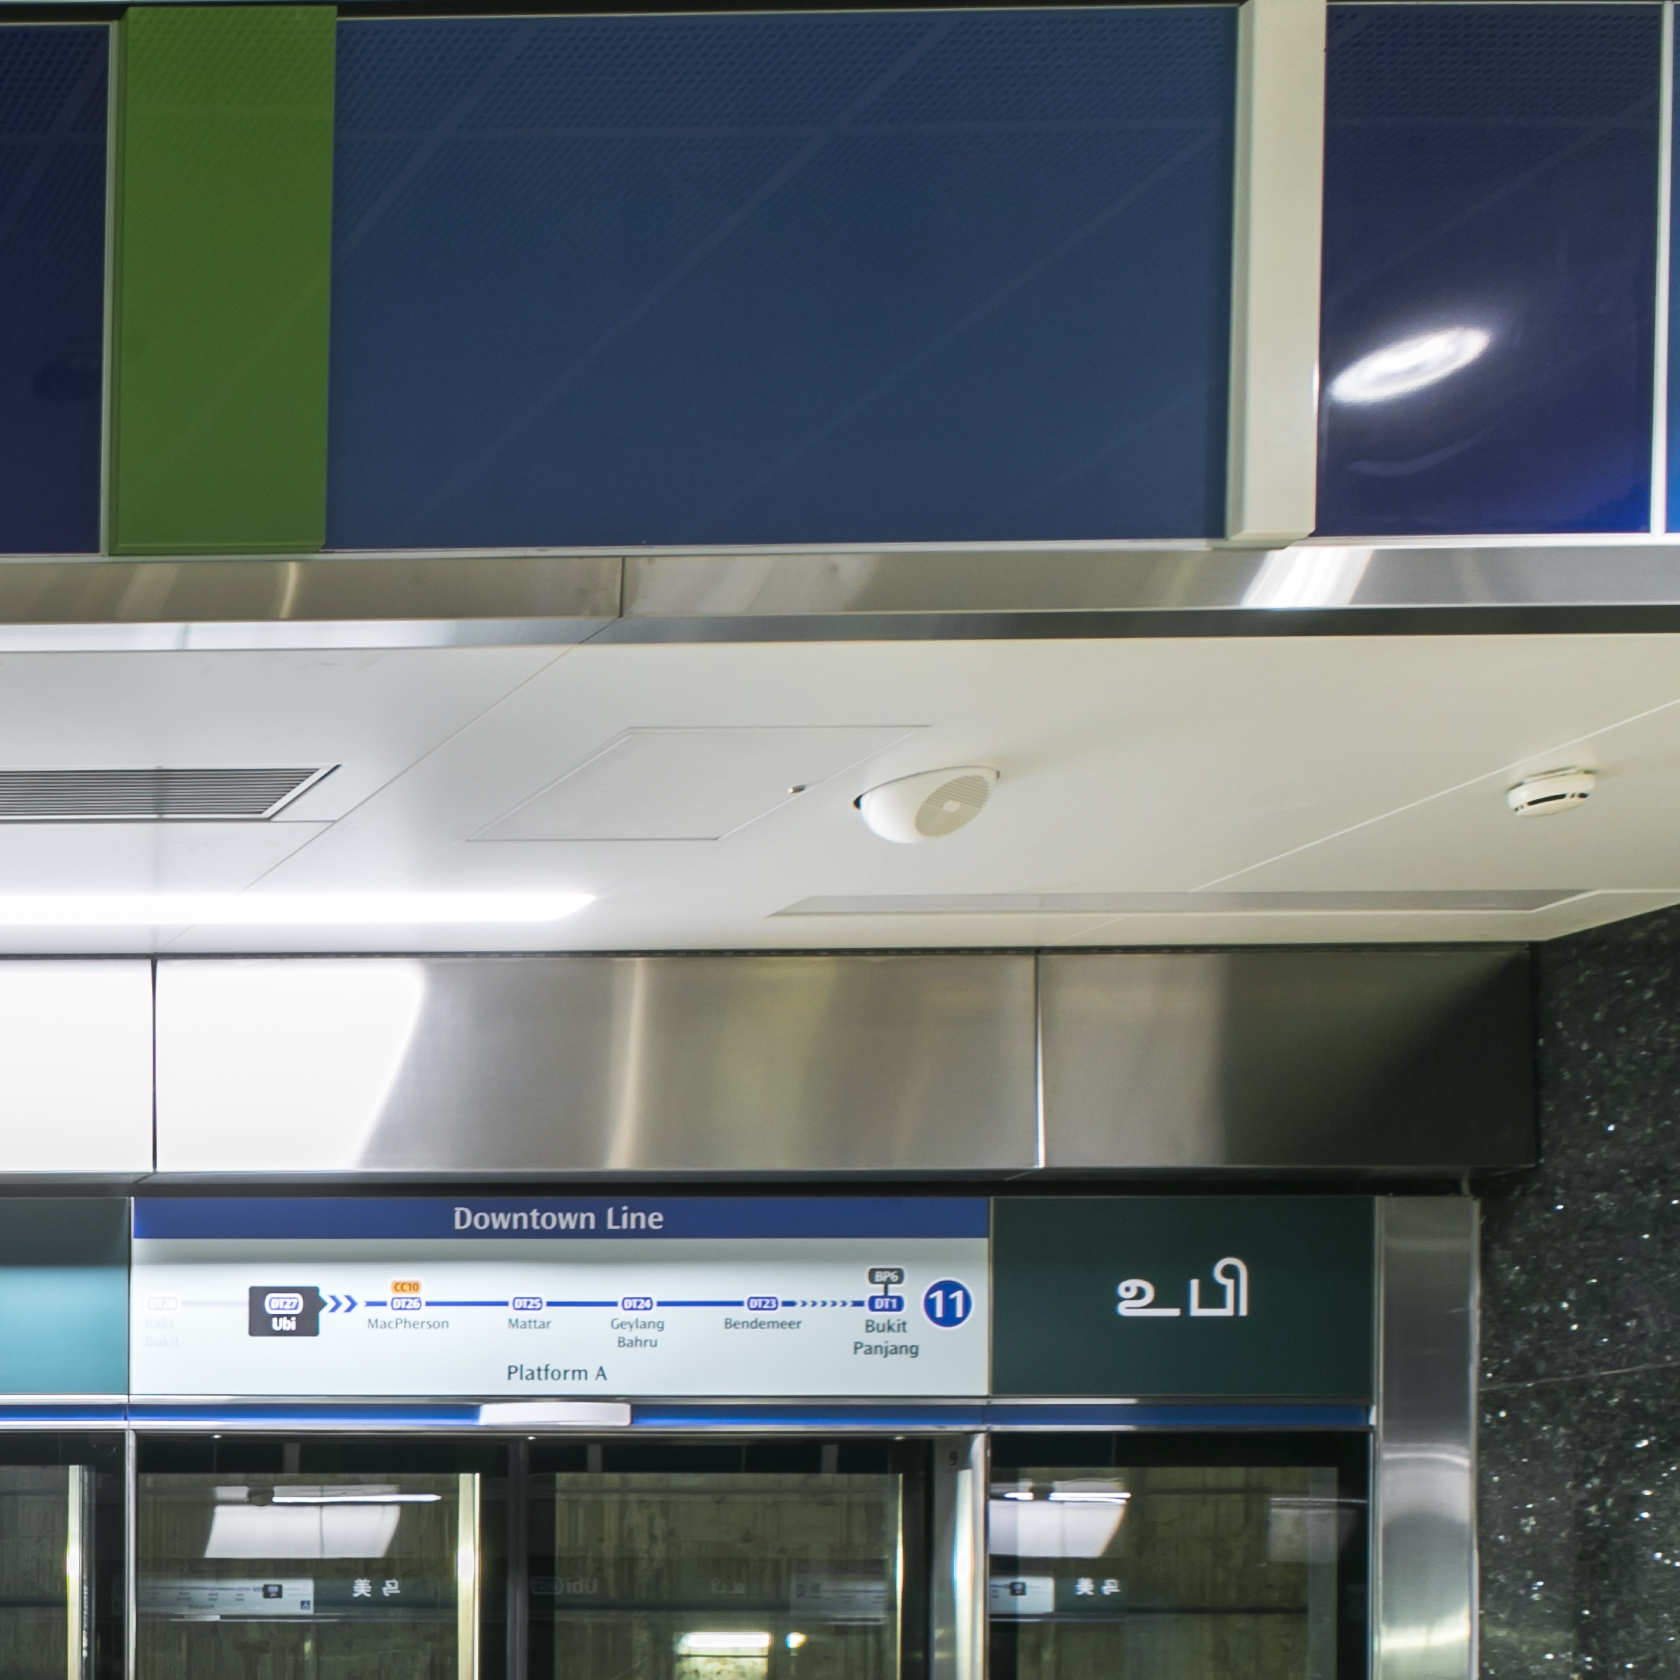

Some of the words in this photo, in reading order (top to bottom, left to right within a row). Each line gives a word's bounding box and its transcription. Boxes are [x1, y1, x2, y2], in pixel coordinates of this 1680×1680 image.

[453, 1205, 596, 1231] Downtown
[605, 1205, 665, 1231] Line
[874, 1270, 900, 1282] BP6
[393, 1281, 420, 1292] CC10
[1116, 1257, 1248, 1317] உபி
[270, 1297, 299, 1310] DT27
[392, 1298, 422, 1310] DT26
[513, 1298, 542, 1310] DT25
[623, 1298, 652, 1310] DT24
[748, 1298, 778, 1310] DT23
[874, 1298, 898, 1310] DT1
[928, 1289, 965, 1318] 11
[271, 1316, 297, 1331] Ubi
[367, 1317, 450, 1330] MacPherson
[507, 1317, 553, 1330] Mattar
[610, 1317, 665, 1333] Geylang
[723, 1317, 803, 1330] Bendemeer
[864, 1318, 908, 1334] Bukit
[617, 1336, 658, 1348] Bahru
[852, 1340, 920, 1359] Panjang
[507, 1363, 588, 1382] Platform
[595, 1365, 608, 1382] A
